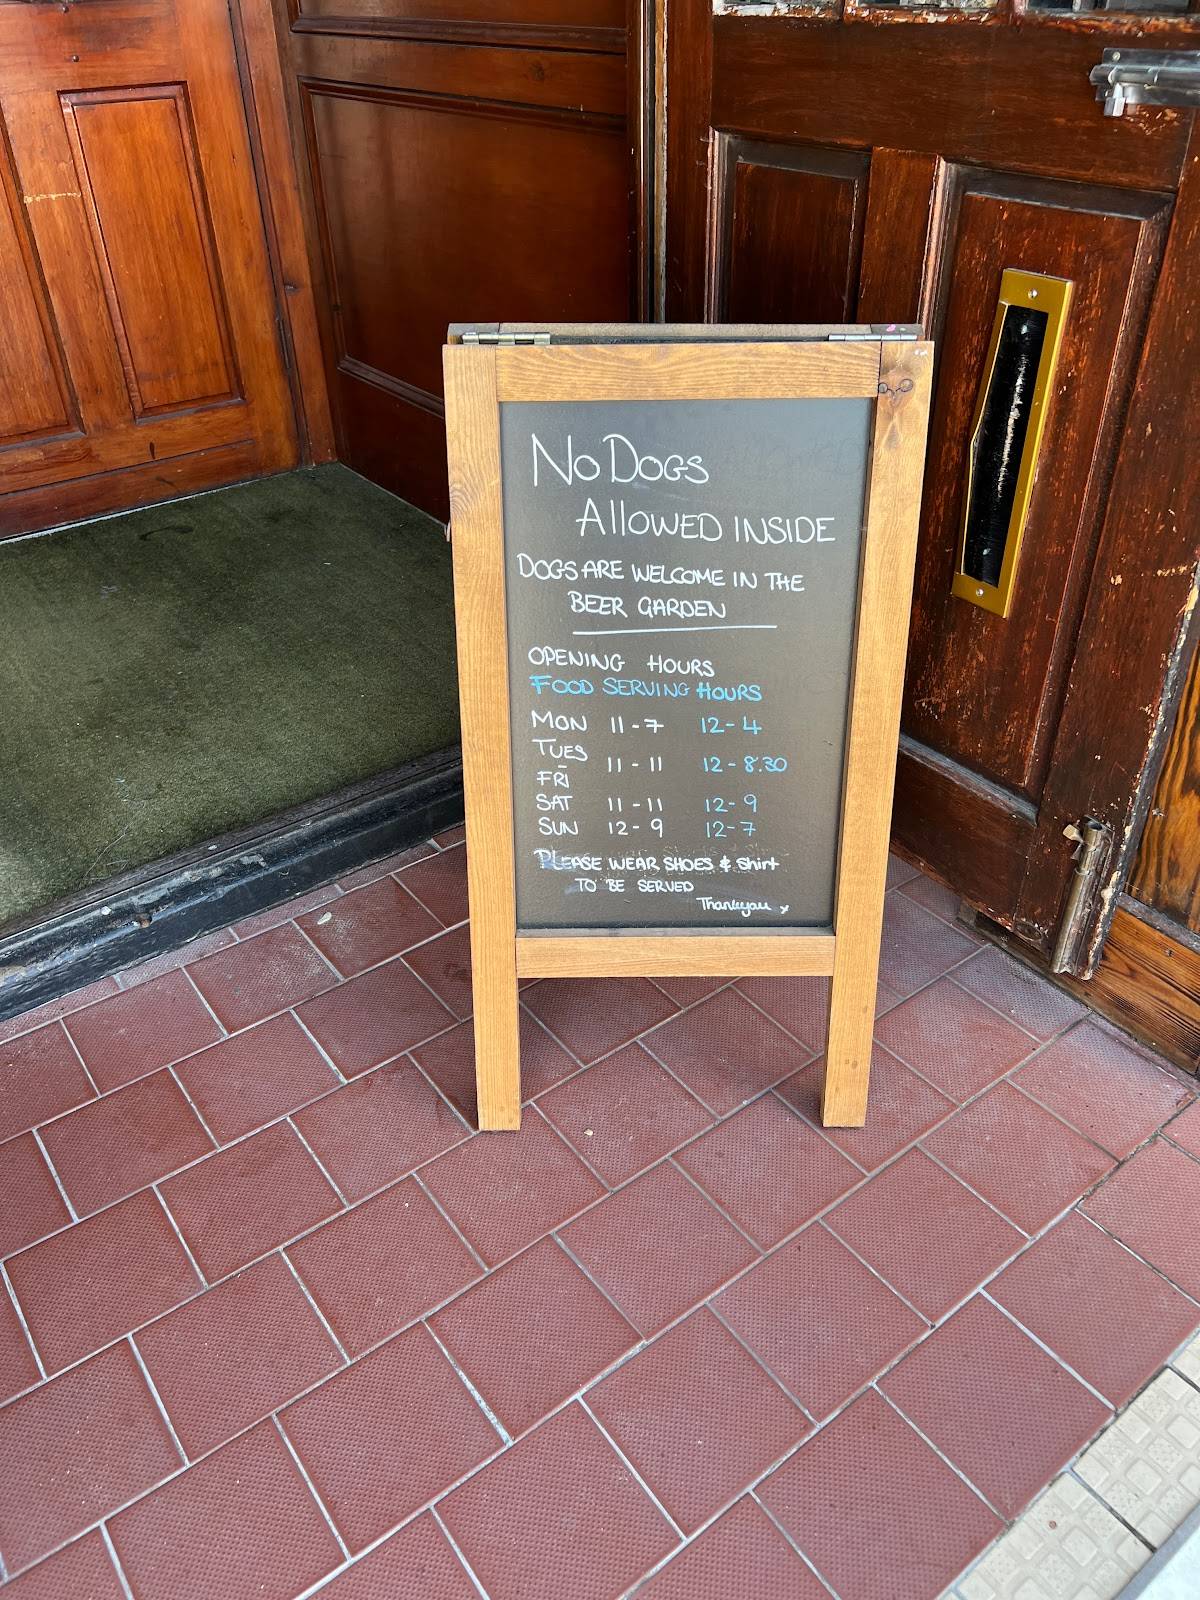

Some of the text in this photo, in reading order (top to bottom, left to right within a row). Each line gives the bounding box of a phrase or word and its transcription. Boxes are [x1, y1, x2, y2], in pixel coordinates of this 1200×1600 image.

[602, 433, 709, 484] DOGS
[734, 515, 836, 544] INSIDE
[516, 552, 805, 592] DOGS ARE WELCOME IN THE
[567, 590, 726, 618] BEER GARDEN
[528, 646, 715, 677] OPENING HOURS
[529, 674, 762, 702] FOOD SERVING HOURS
[530, 710, 588, 732] MON
[532, 738, 589, 762] TUES
[536, 771, 570, 789] FRI
[535, 793, 574, 812] SAT
[537, 816, 579, 836] SUN
[533, 848, 603, 872] PLEASE
[608, 857, 660, 871] WEAR
[662, 856, 714, 872] SHOES
[575, 877, 695, 893] TO BE SERVED
